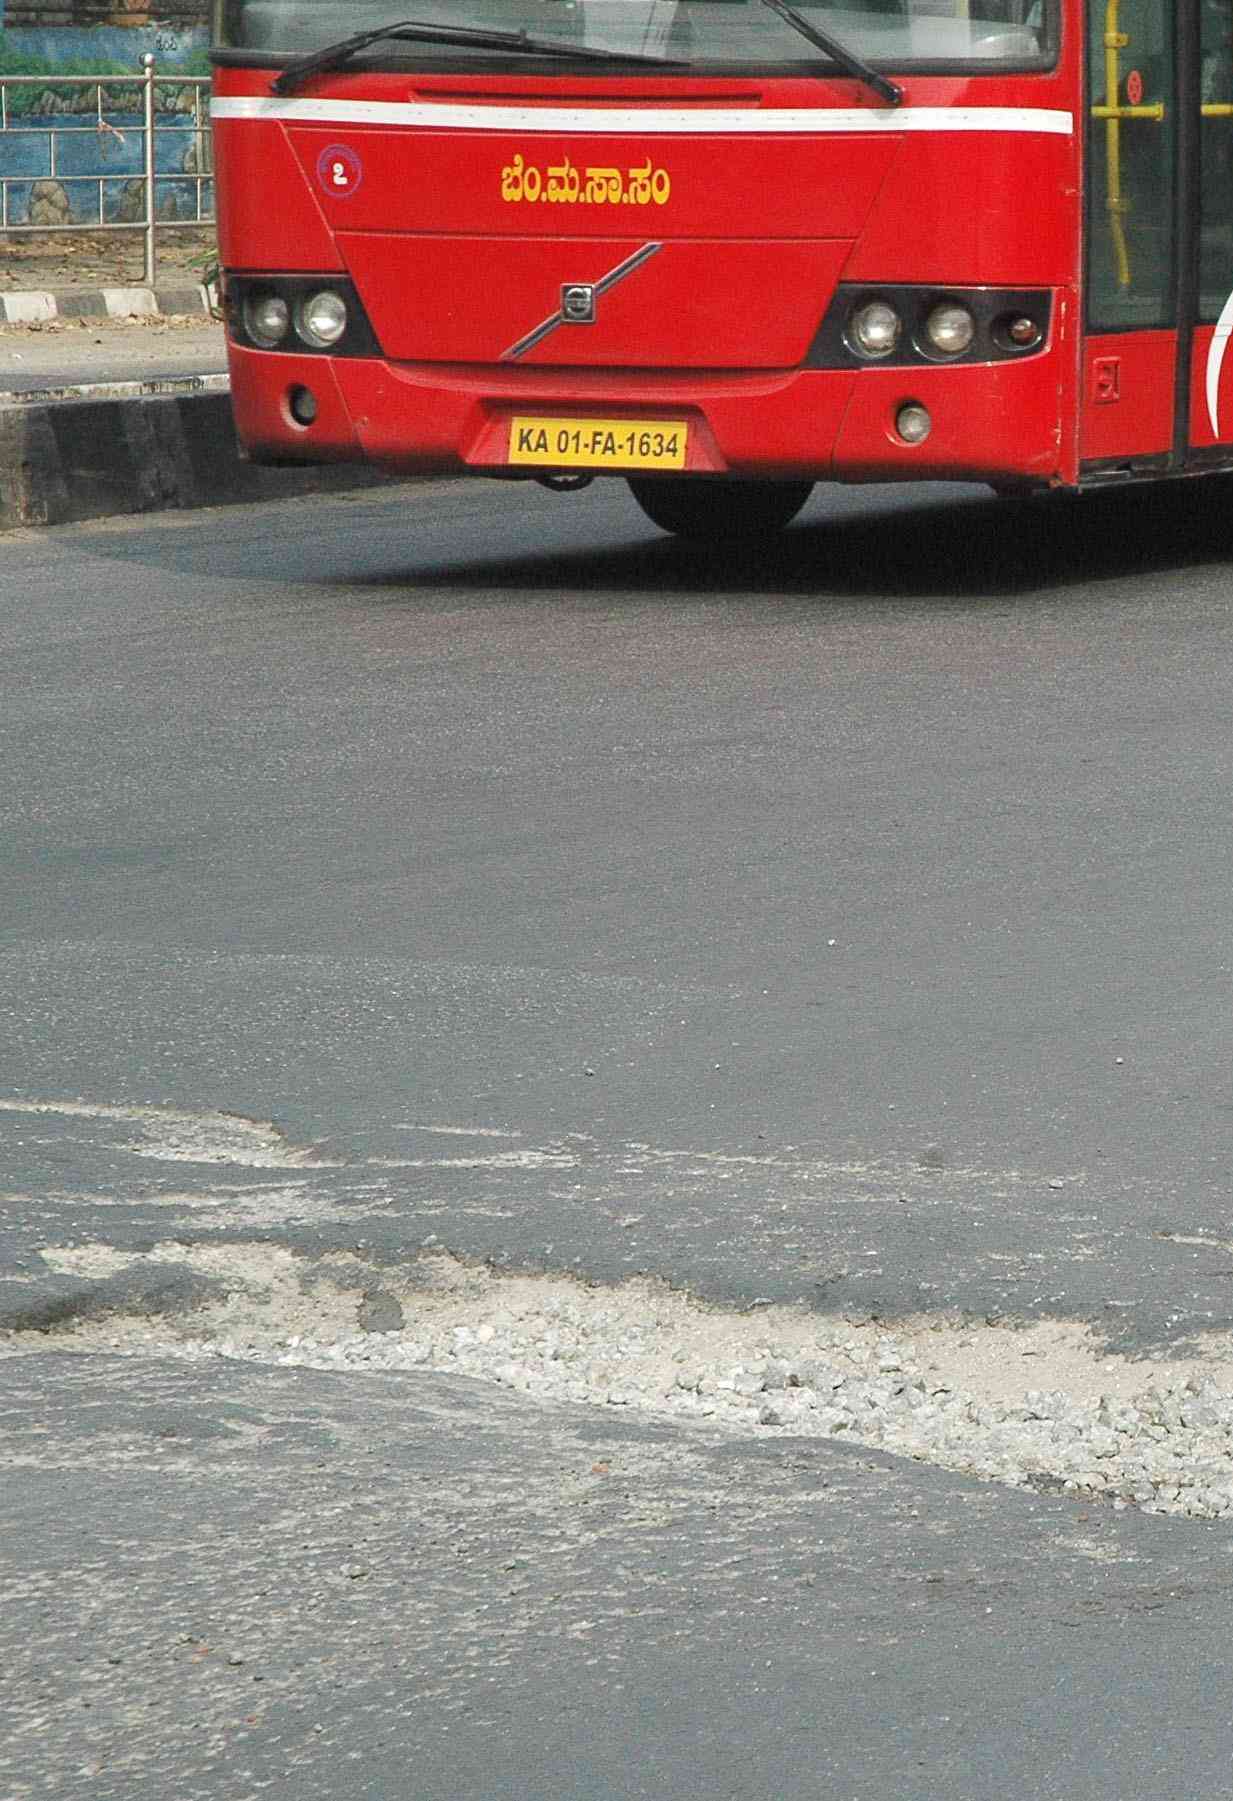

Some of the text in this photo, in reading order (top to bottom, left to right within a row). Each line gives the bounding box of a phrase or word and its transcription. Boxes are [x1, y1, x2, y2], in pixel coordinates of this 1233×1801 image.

[332, 162, 349, 185] 2
[518, 428, 678, 458] KA 01-FA-1634
